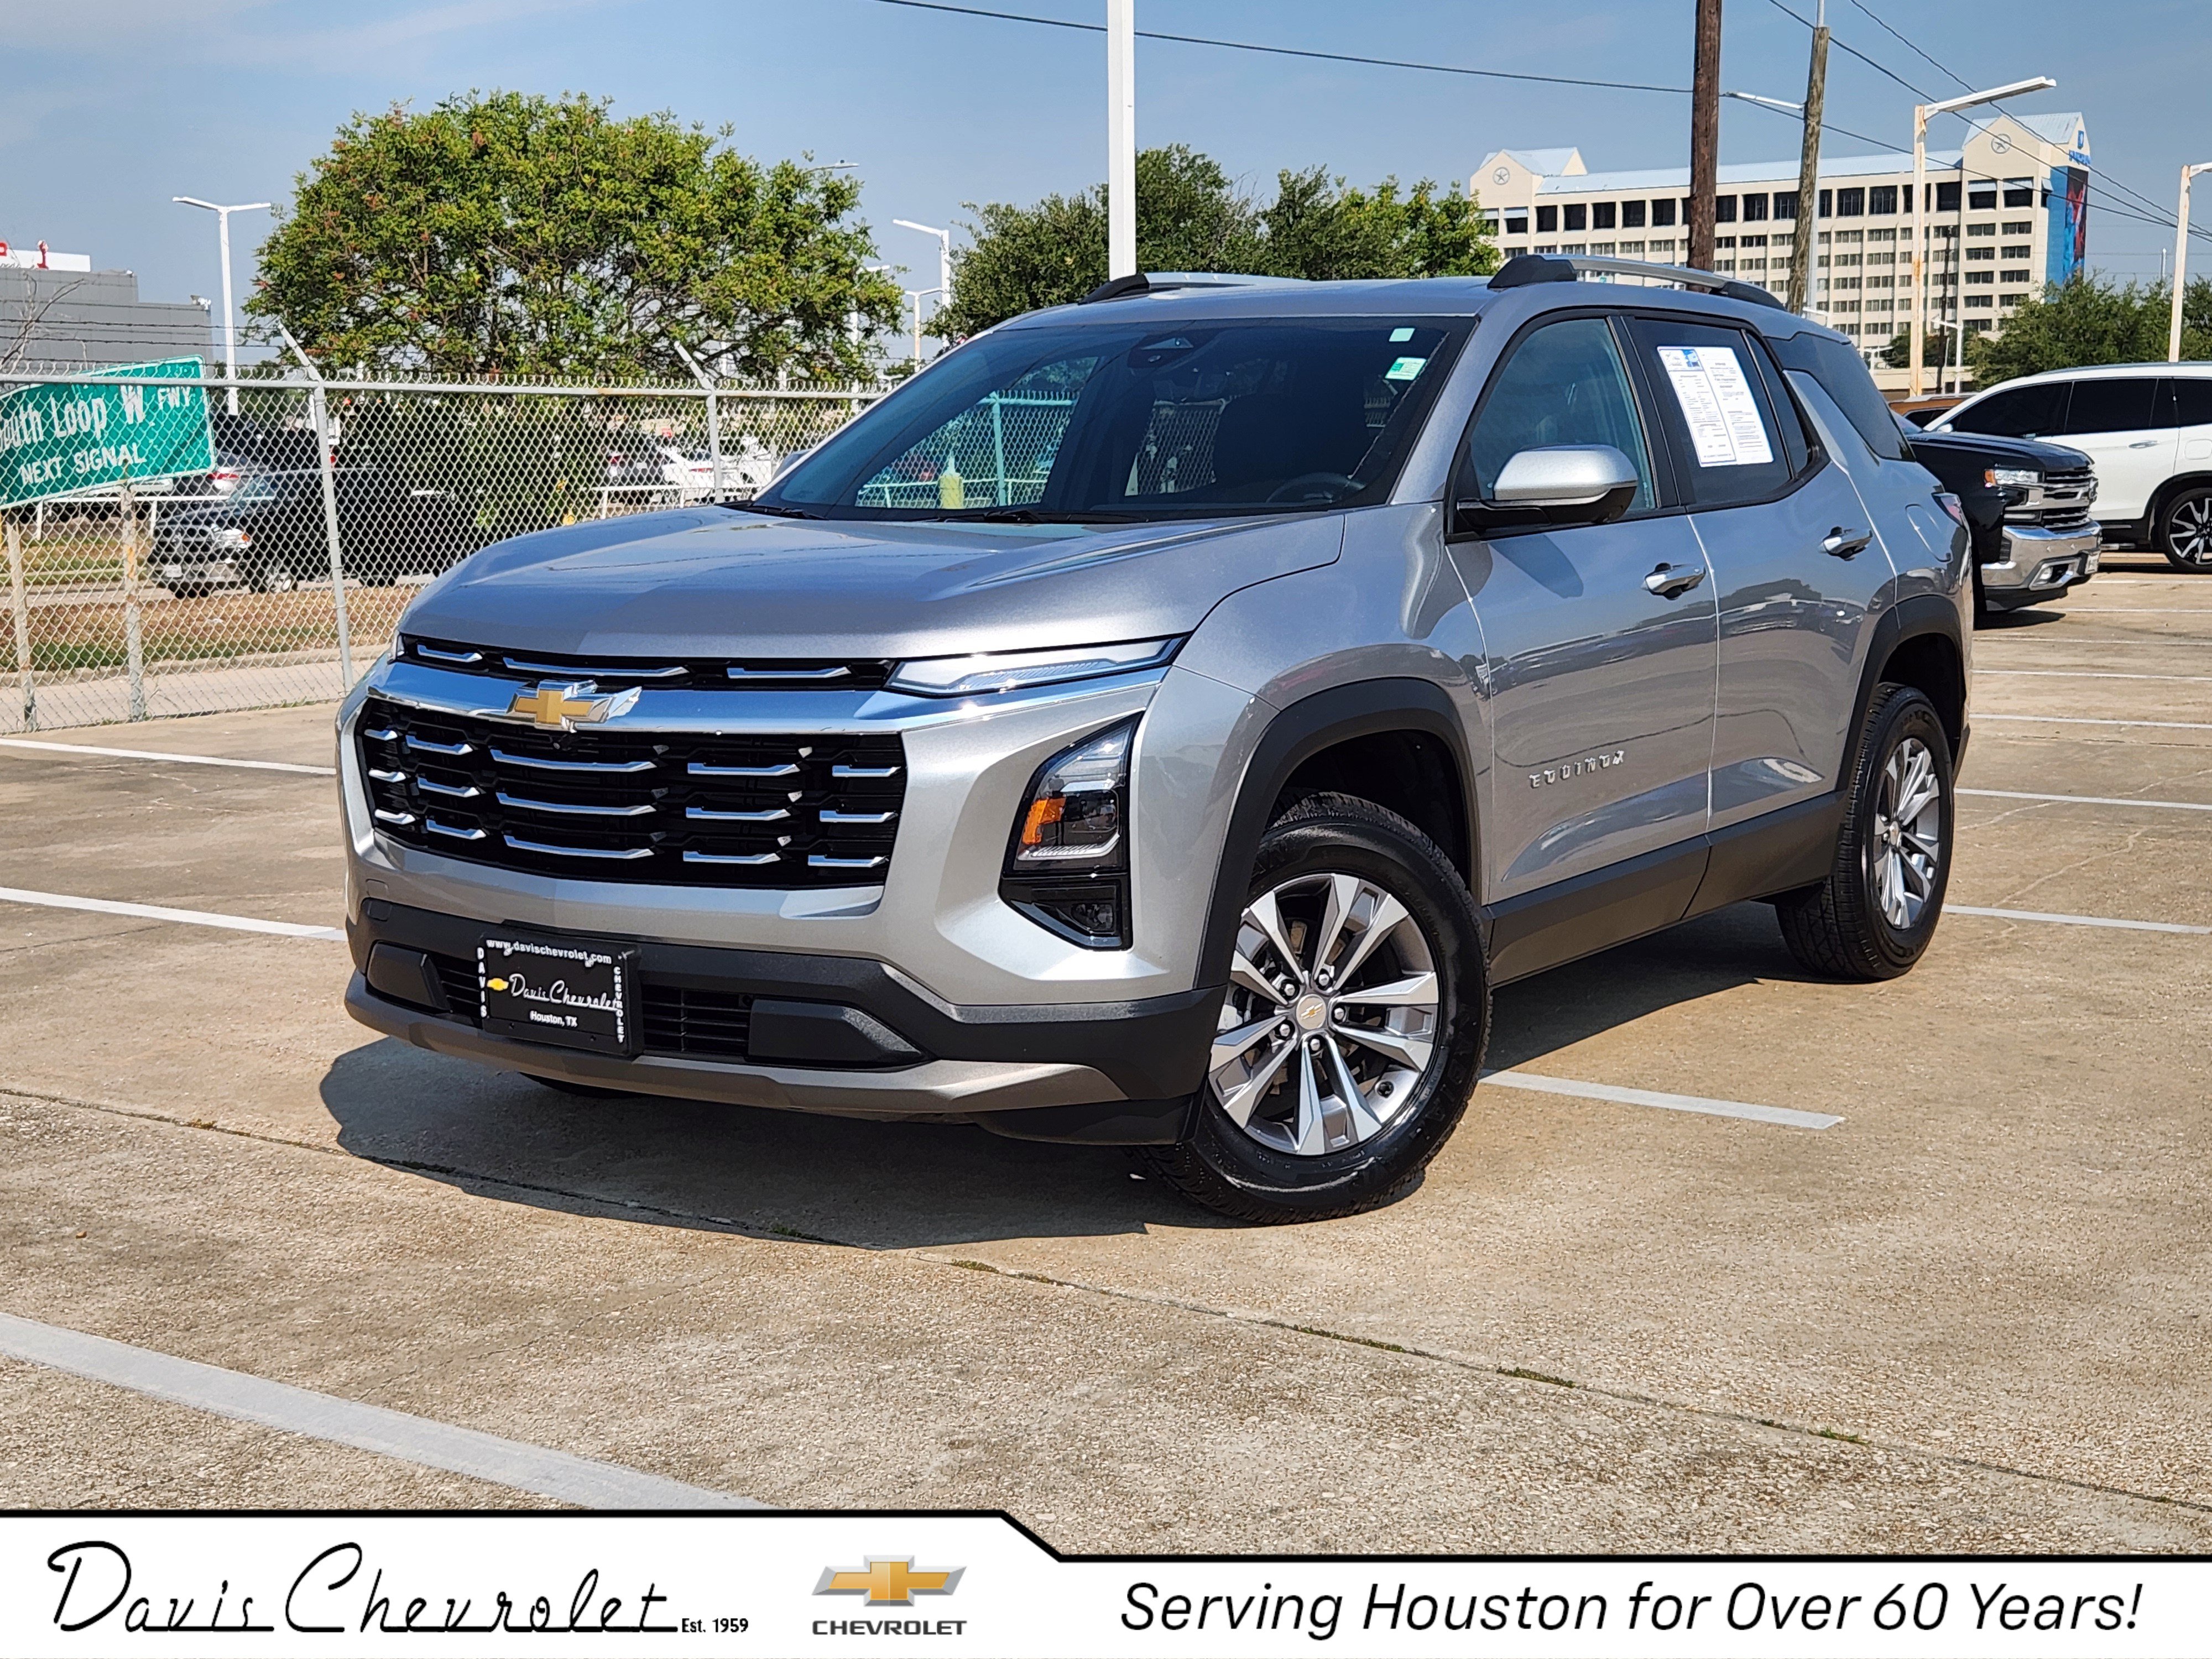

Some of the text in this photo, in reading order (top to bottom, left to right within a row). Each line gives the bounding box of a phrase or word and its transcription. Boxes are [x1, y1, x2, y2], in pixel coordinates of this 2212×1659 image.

[50, 397, 107, 441] Loop
[121, 385, 146, 425] W
[158, 386, 191, 410] FWY
[20, 444, 146, 486] NEXT SIGNAL
[1528, 750, 1625, 789] EQUINOX
[486, 940, 612, 965] www.davischevrolet.com
[477, 947, 487, 1018] DAVIS
[509, 973, 618, 1011] Davis Chevrolet
[529, 1010, 578, 1027] Houston, TX
[613, 966, 625, 1044] CHEVROLET
